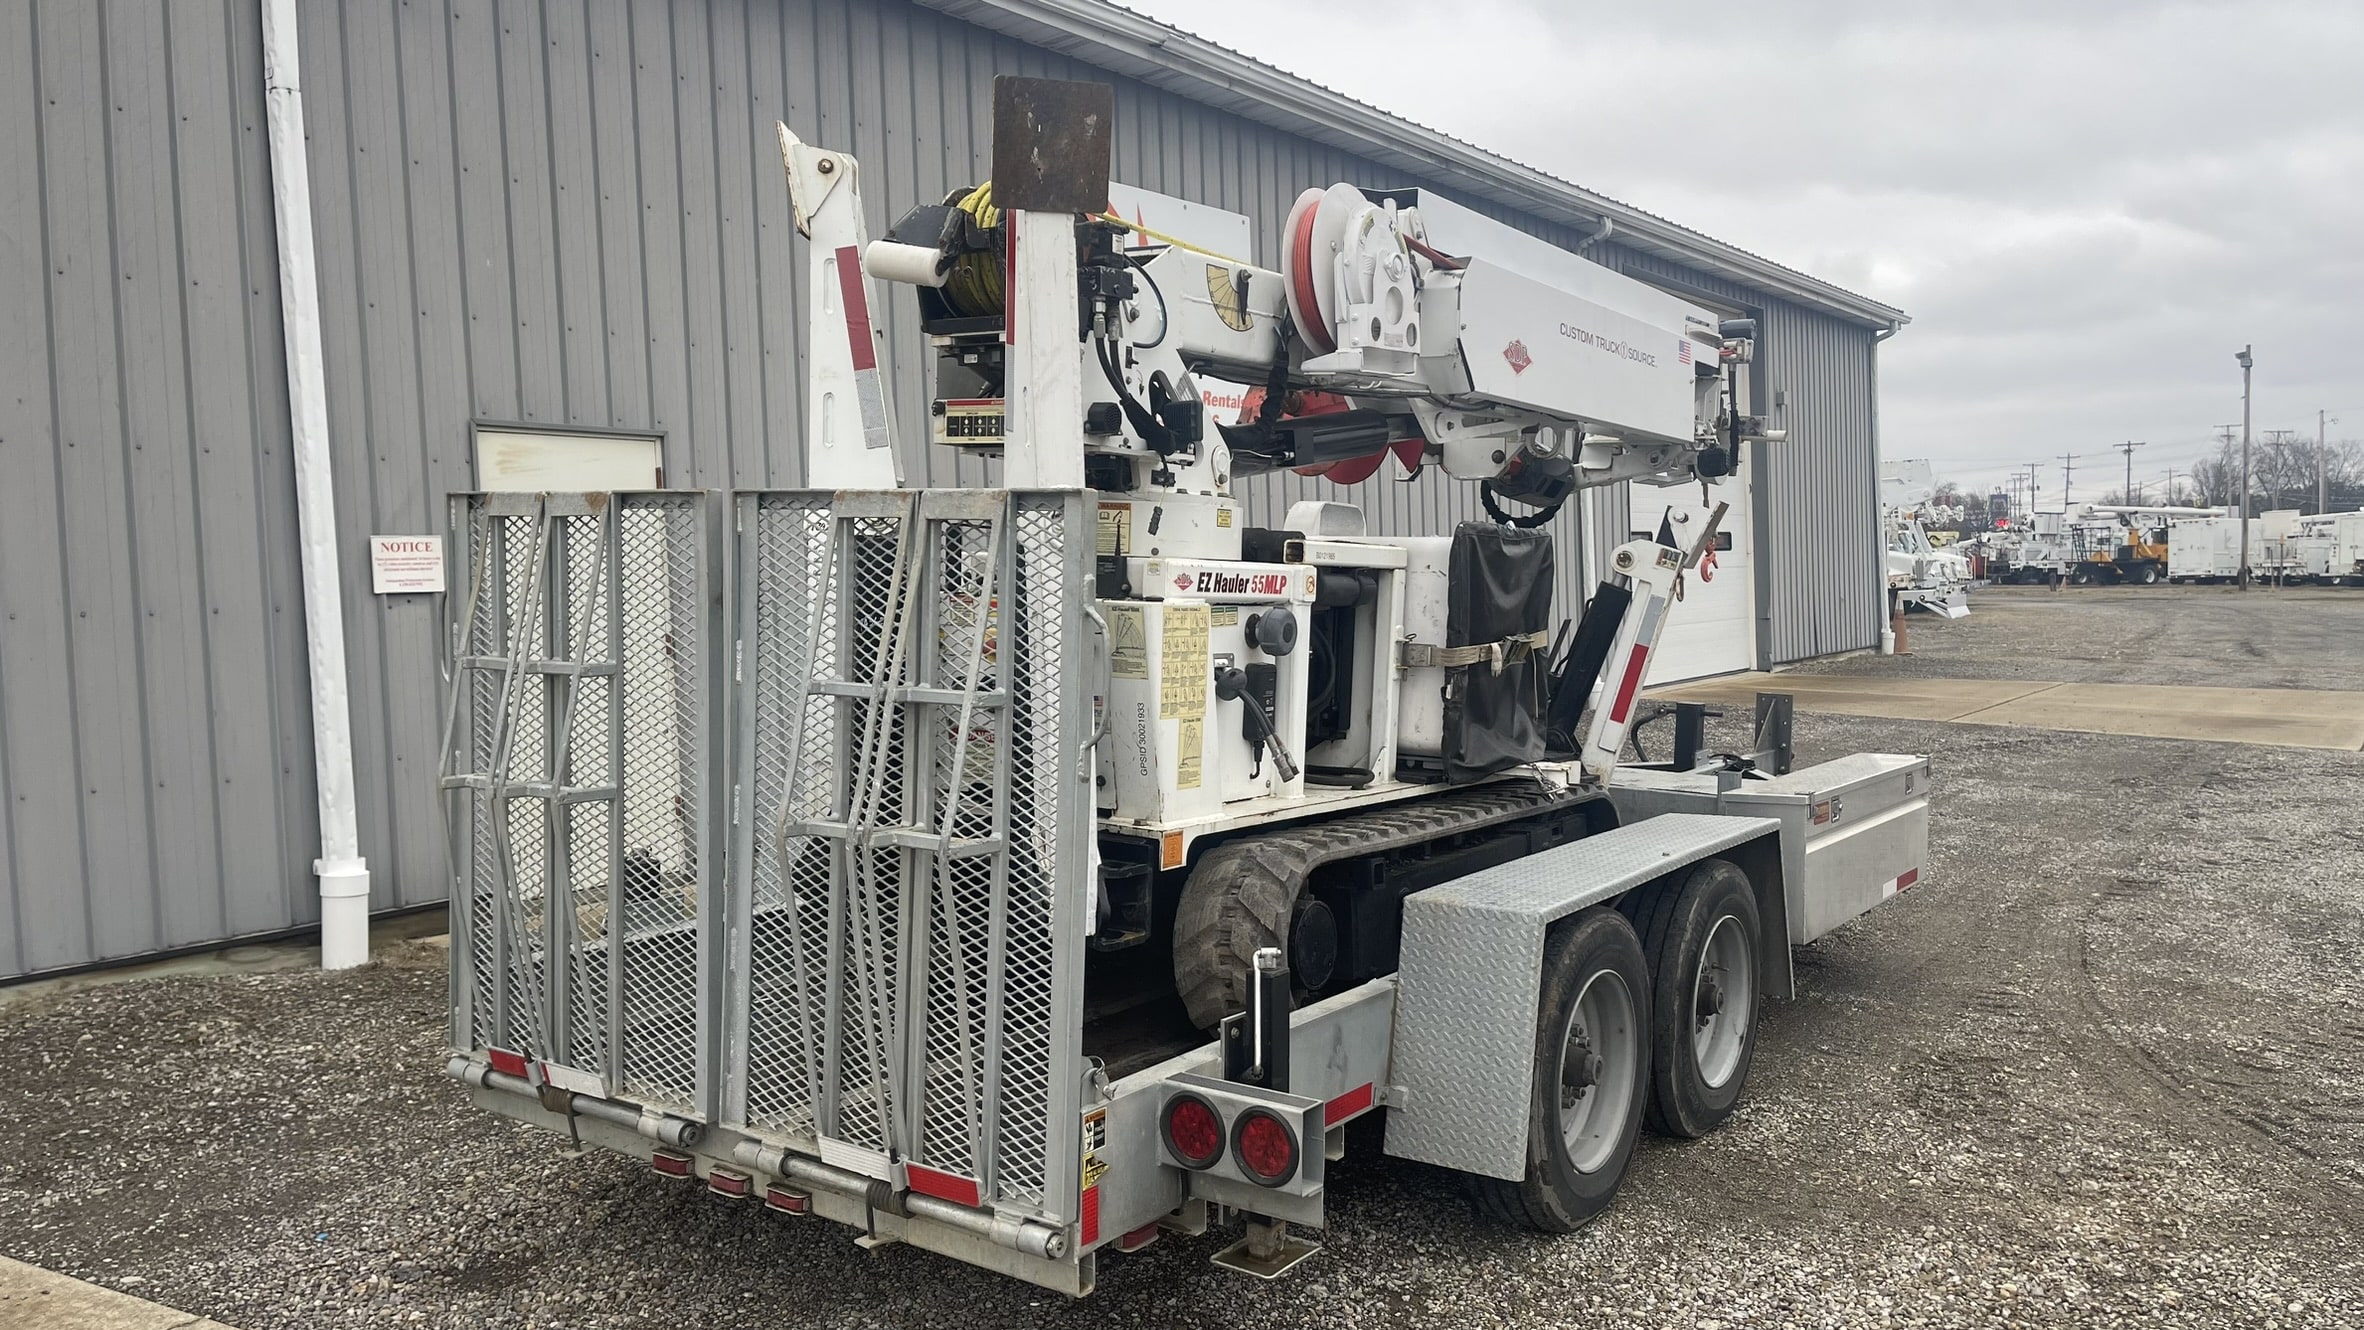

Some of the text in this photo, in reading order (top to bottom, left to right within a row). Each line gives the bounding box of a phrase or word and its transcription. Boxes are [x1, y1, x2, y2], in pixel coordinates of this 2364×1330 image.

[1560, 322, 1594, 346] CUSTOM
[1595, 335, 1620, 356] TRUCK
[1628, 347, 1656, 367] SOURCE
[381, 541, 433, 553] NOTICE
[1197, 572, 1288, 595] EZ Hauler 55MLP
[1137, 702, 1148, 776] GPSID 30021933
